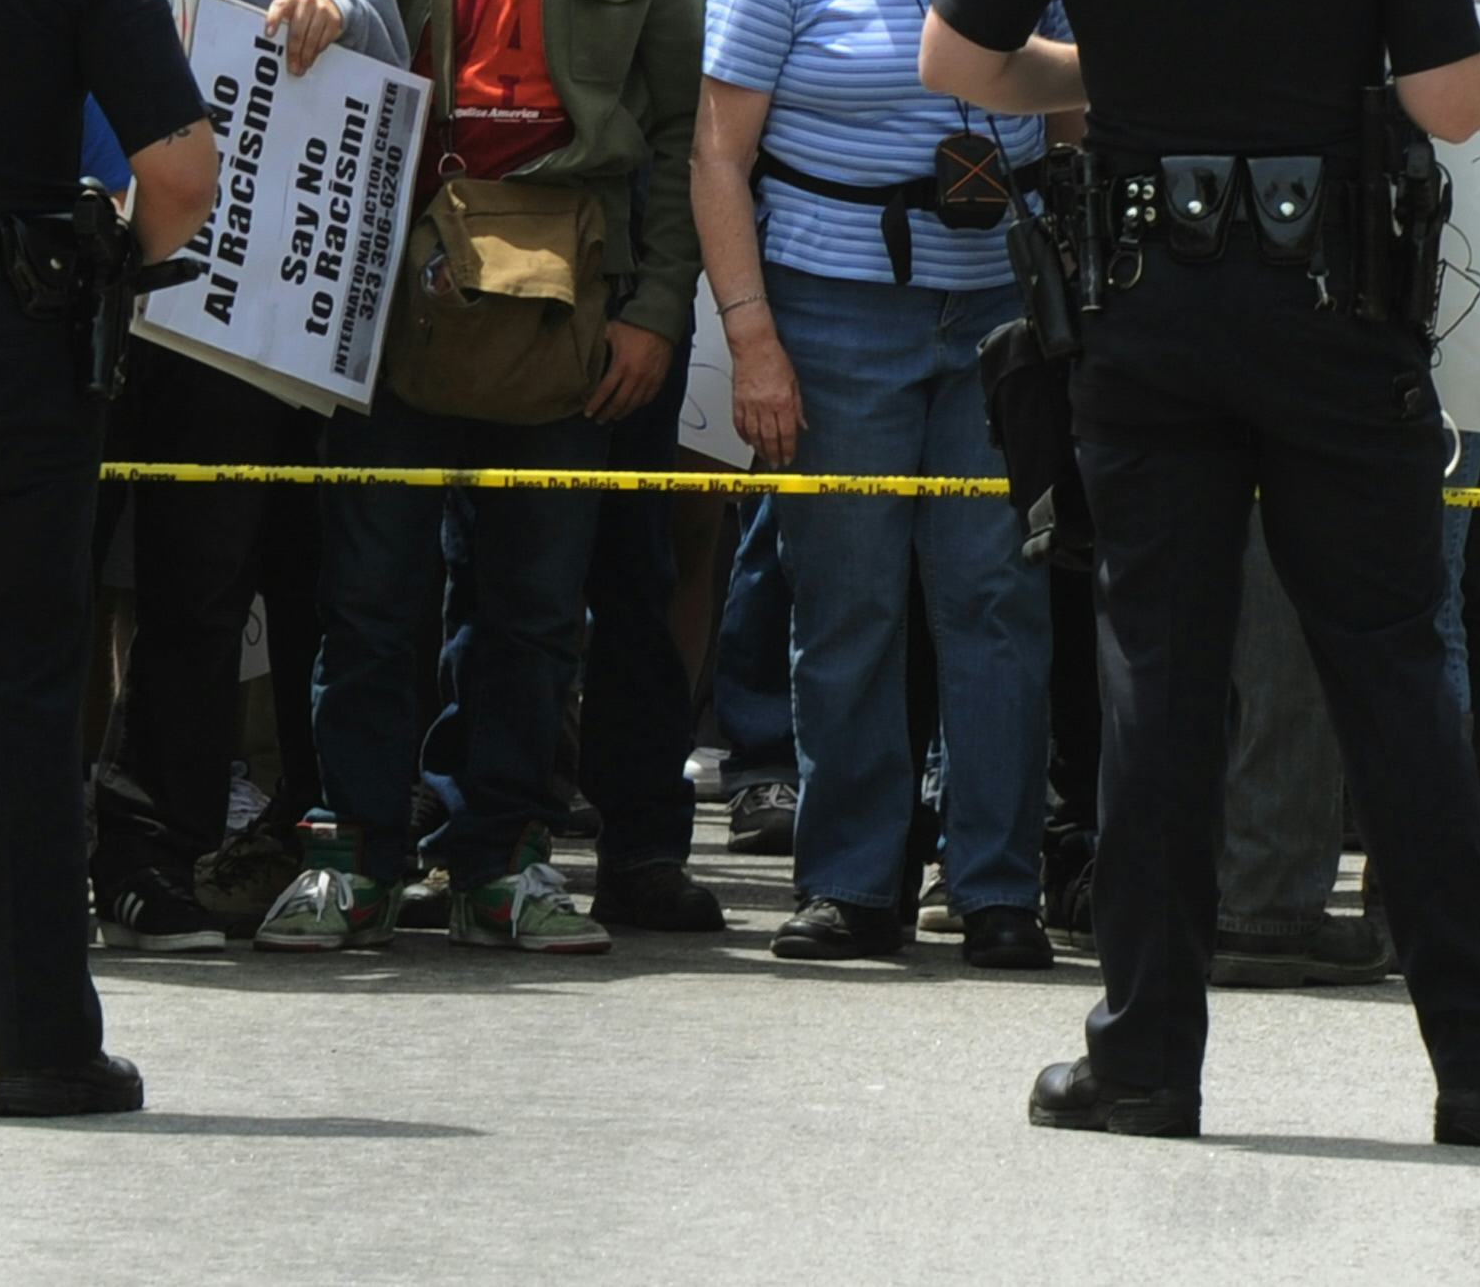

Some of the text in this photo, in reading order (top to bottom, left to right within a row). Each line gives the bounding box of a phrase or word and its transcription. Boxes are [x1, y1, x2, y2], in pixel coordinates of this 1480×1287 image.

[217, 36, 284, 266] Racismo!
[281, 137, 327, 285] Say No
[305, 96, 369, 337] to Racism!
[334, 83, 398, 375] INTERNATIONAL ACTION CENTER
[359, 146, 403, 320] 323 306-6240
[204, 273, 238, 325] Al
